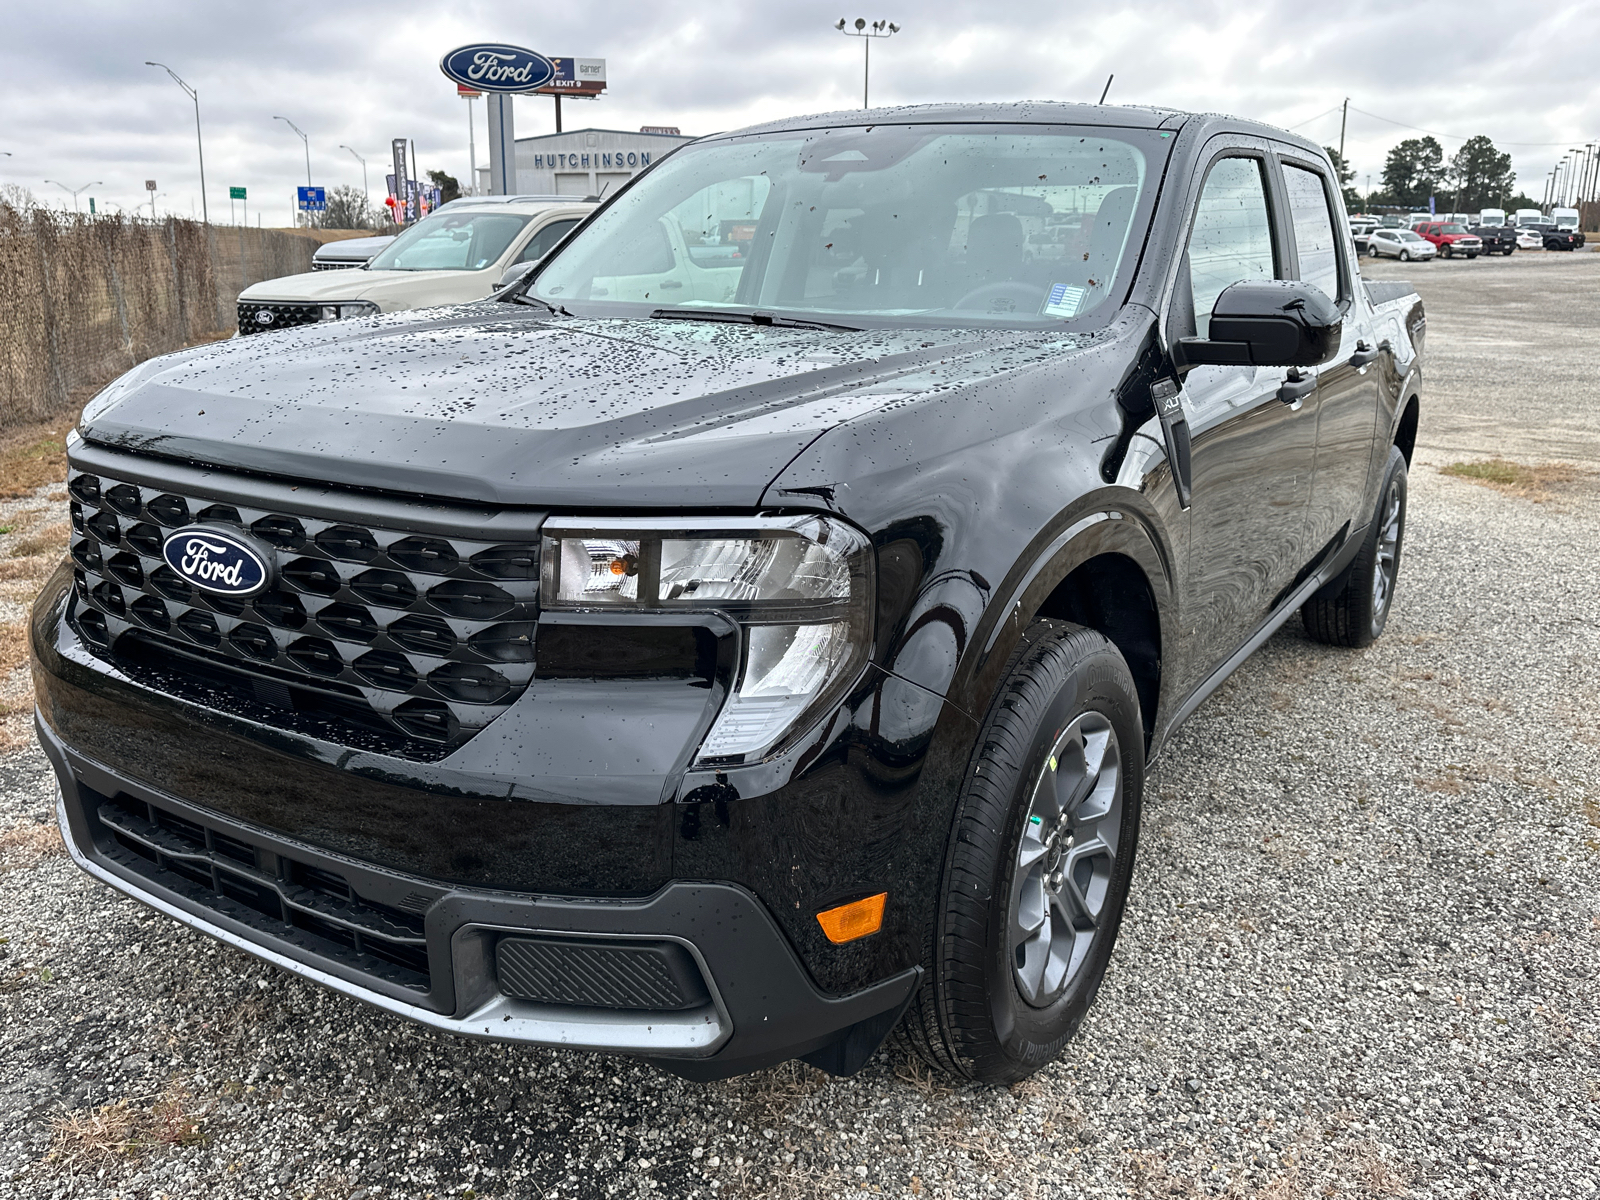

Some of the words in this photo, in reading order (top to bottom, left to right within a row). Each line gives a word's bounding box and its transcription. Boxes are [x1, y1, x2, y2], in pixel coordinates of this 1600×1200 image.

[467, 51, 533, 83] Ford
[579, 64, 602, 74] Garner
[576, 80, 582, 88] 9
[534, 152, 652, 168] HUTCHINSON
[1161, 395, 1181, 412] XLT
[181, 538, 244, 586] Ford
[1086, 663, 1132, 696] Continental
